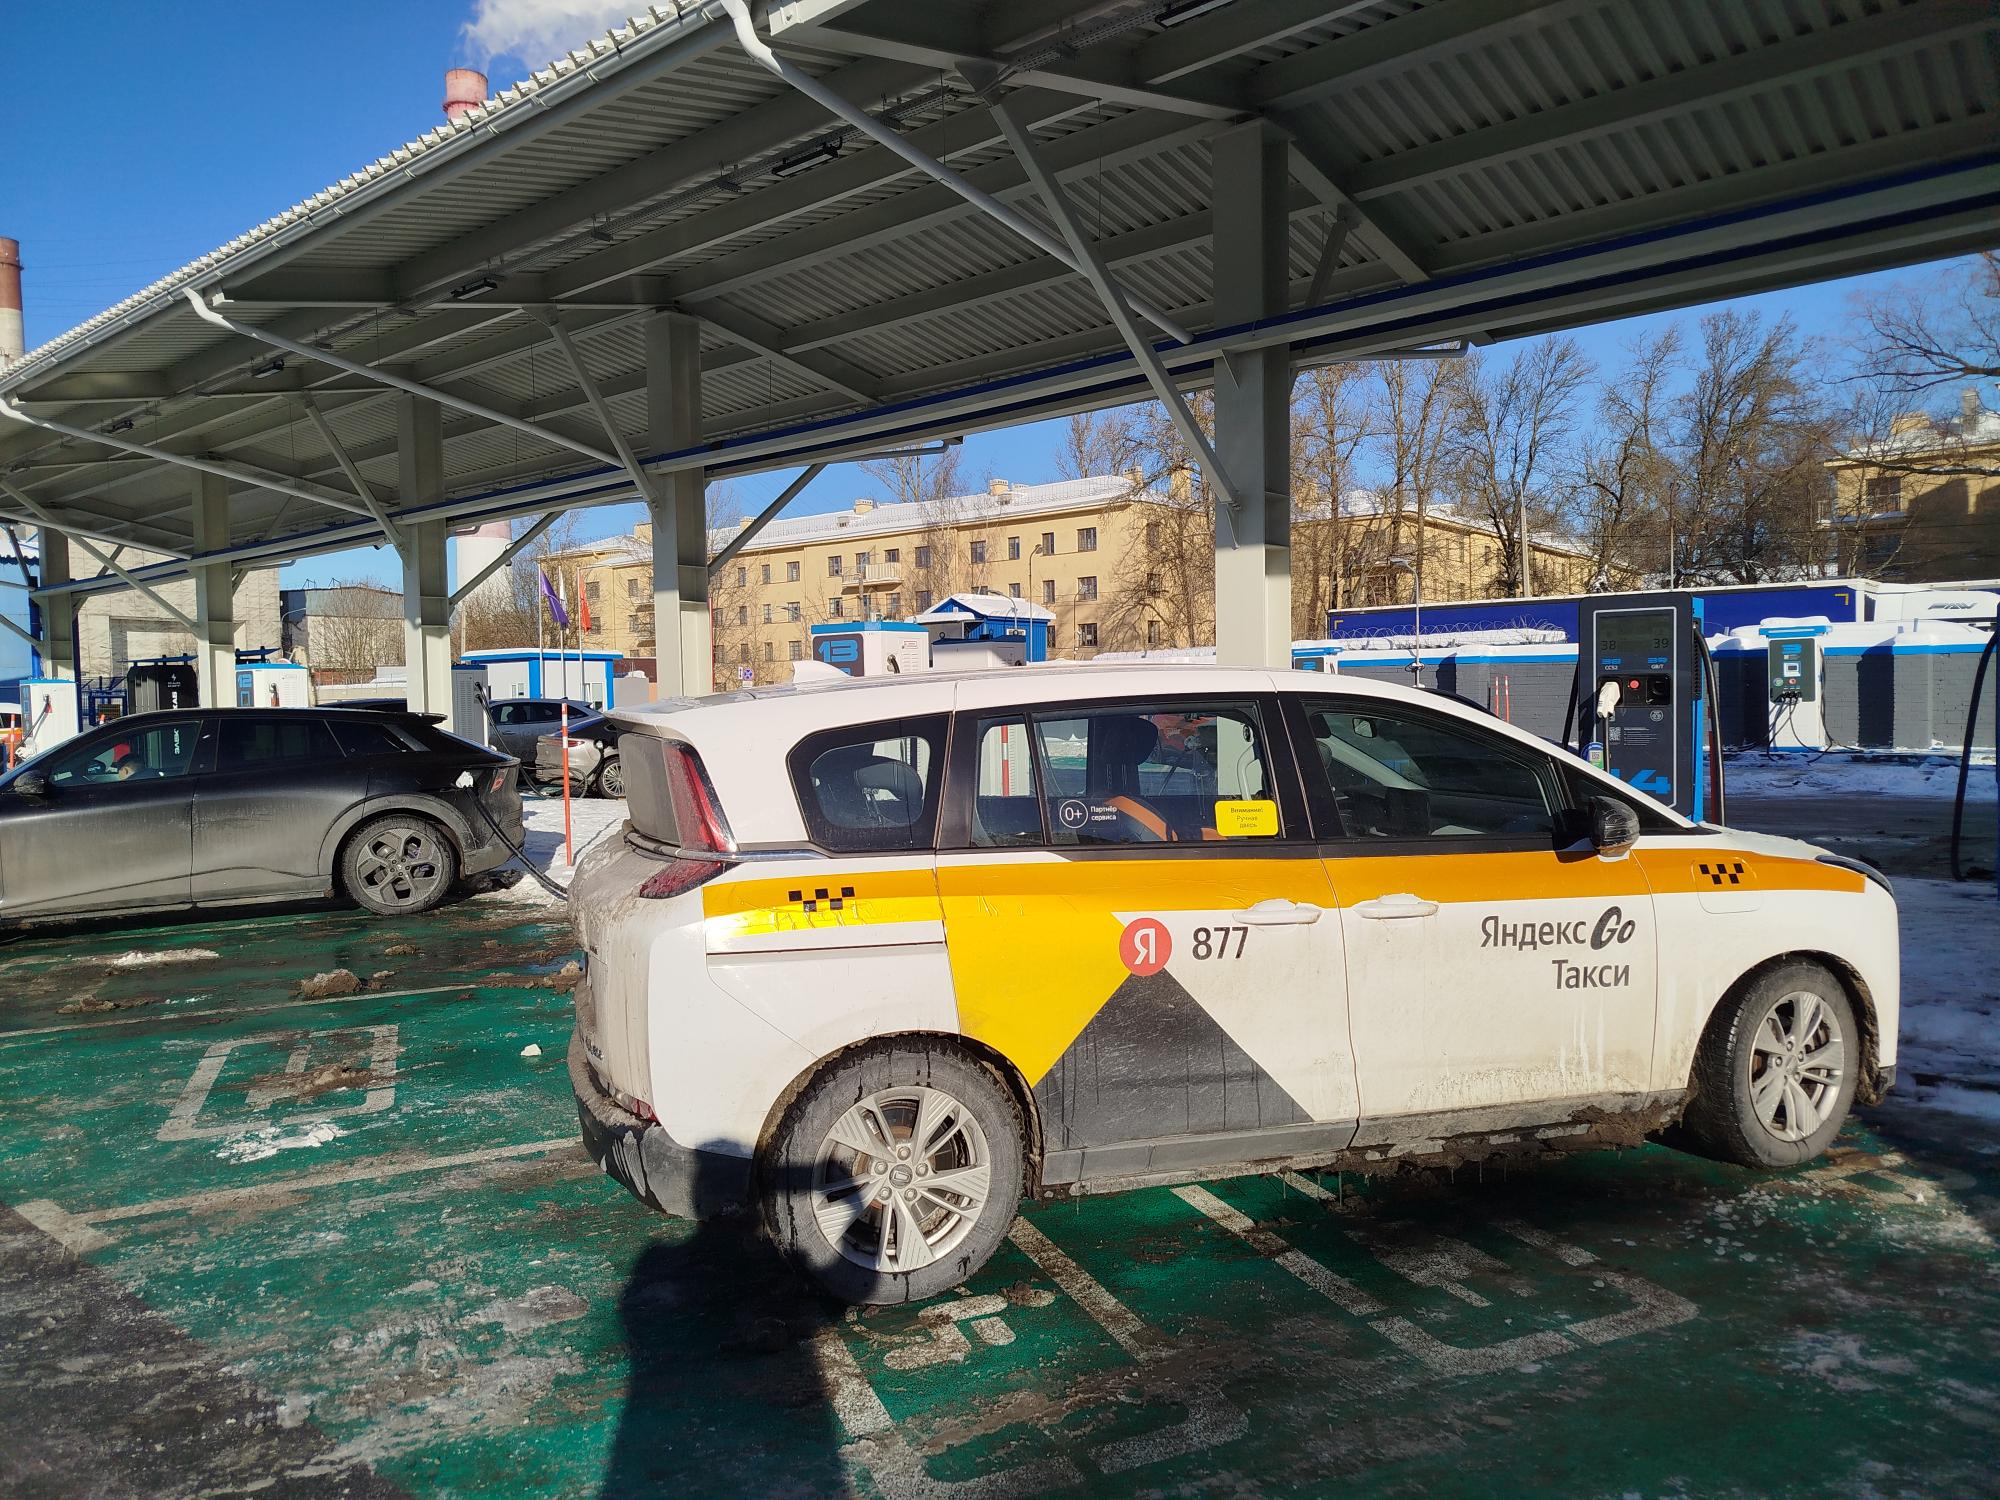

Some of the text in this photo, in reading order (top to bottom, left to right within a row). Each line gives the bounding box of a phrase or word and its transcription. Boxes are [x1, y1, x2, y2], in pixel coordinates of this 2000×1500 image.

[818, 640, 858, 663] 13
[1601, 638, 1669, 650] 38 39
[1090, 805, 1117, 814] Партнёр
[1090, 814, 1117, 822] сервиса
[1236, 815, 1258, 823] Ручная
[1480, 905, 1636, 951] Яндекс Go
[1133, 928, 1156, 965] Я
[1192, 926, 1249, 961] 877
[1551, 959, 1630, 990] Такси
